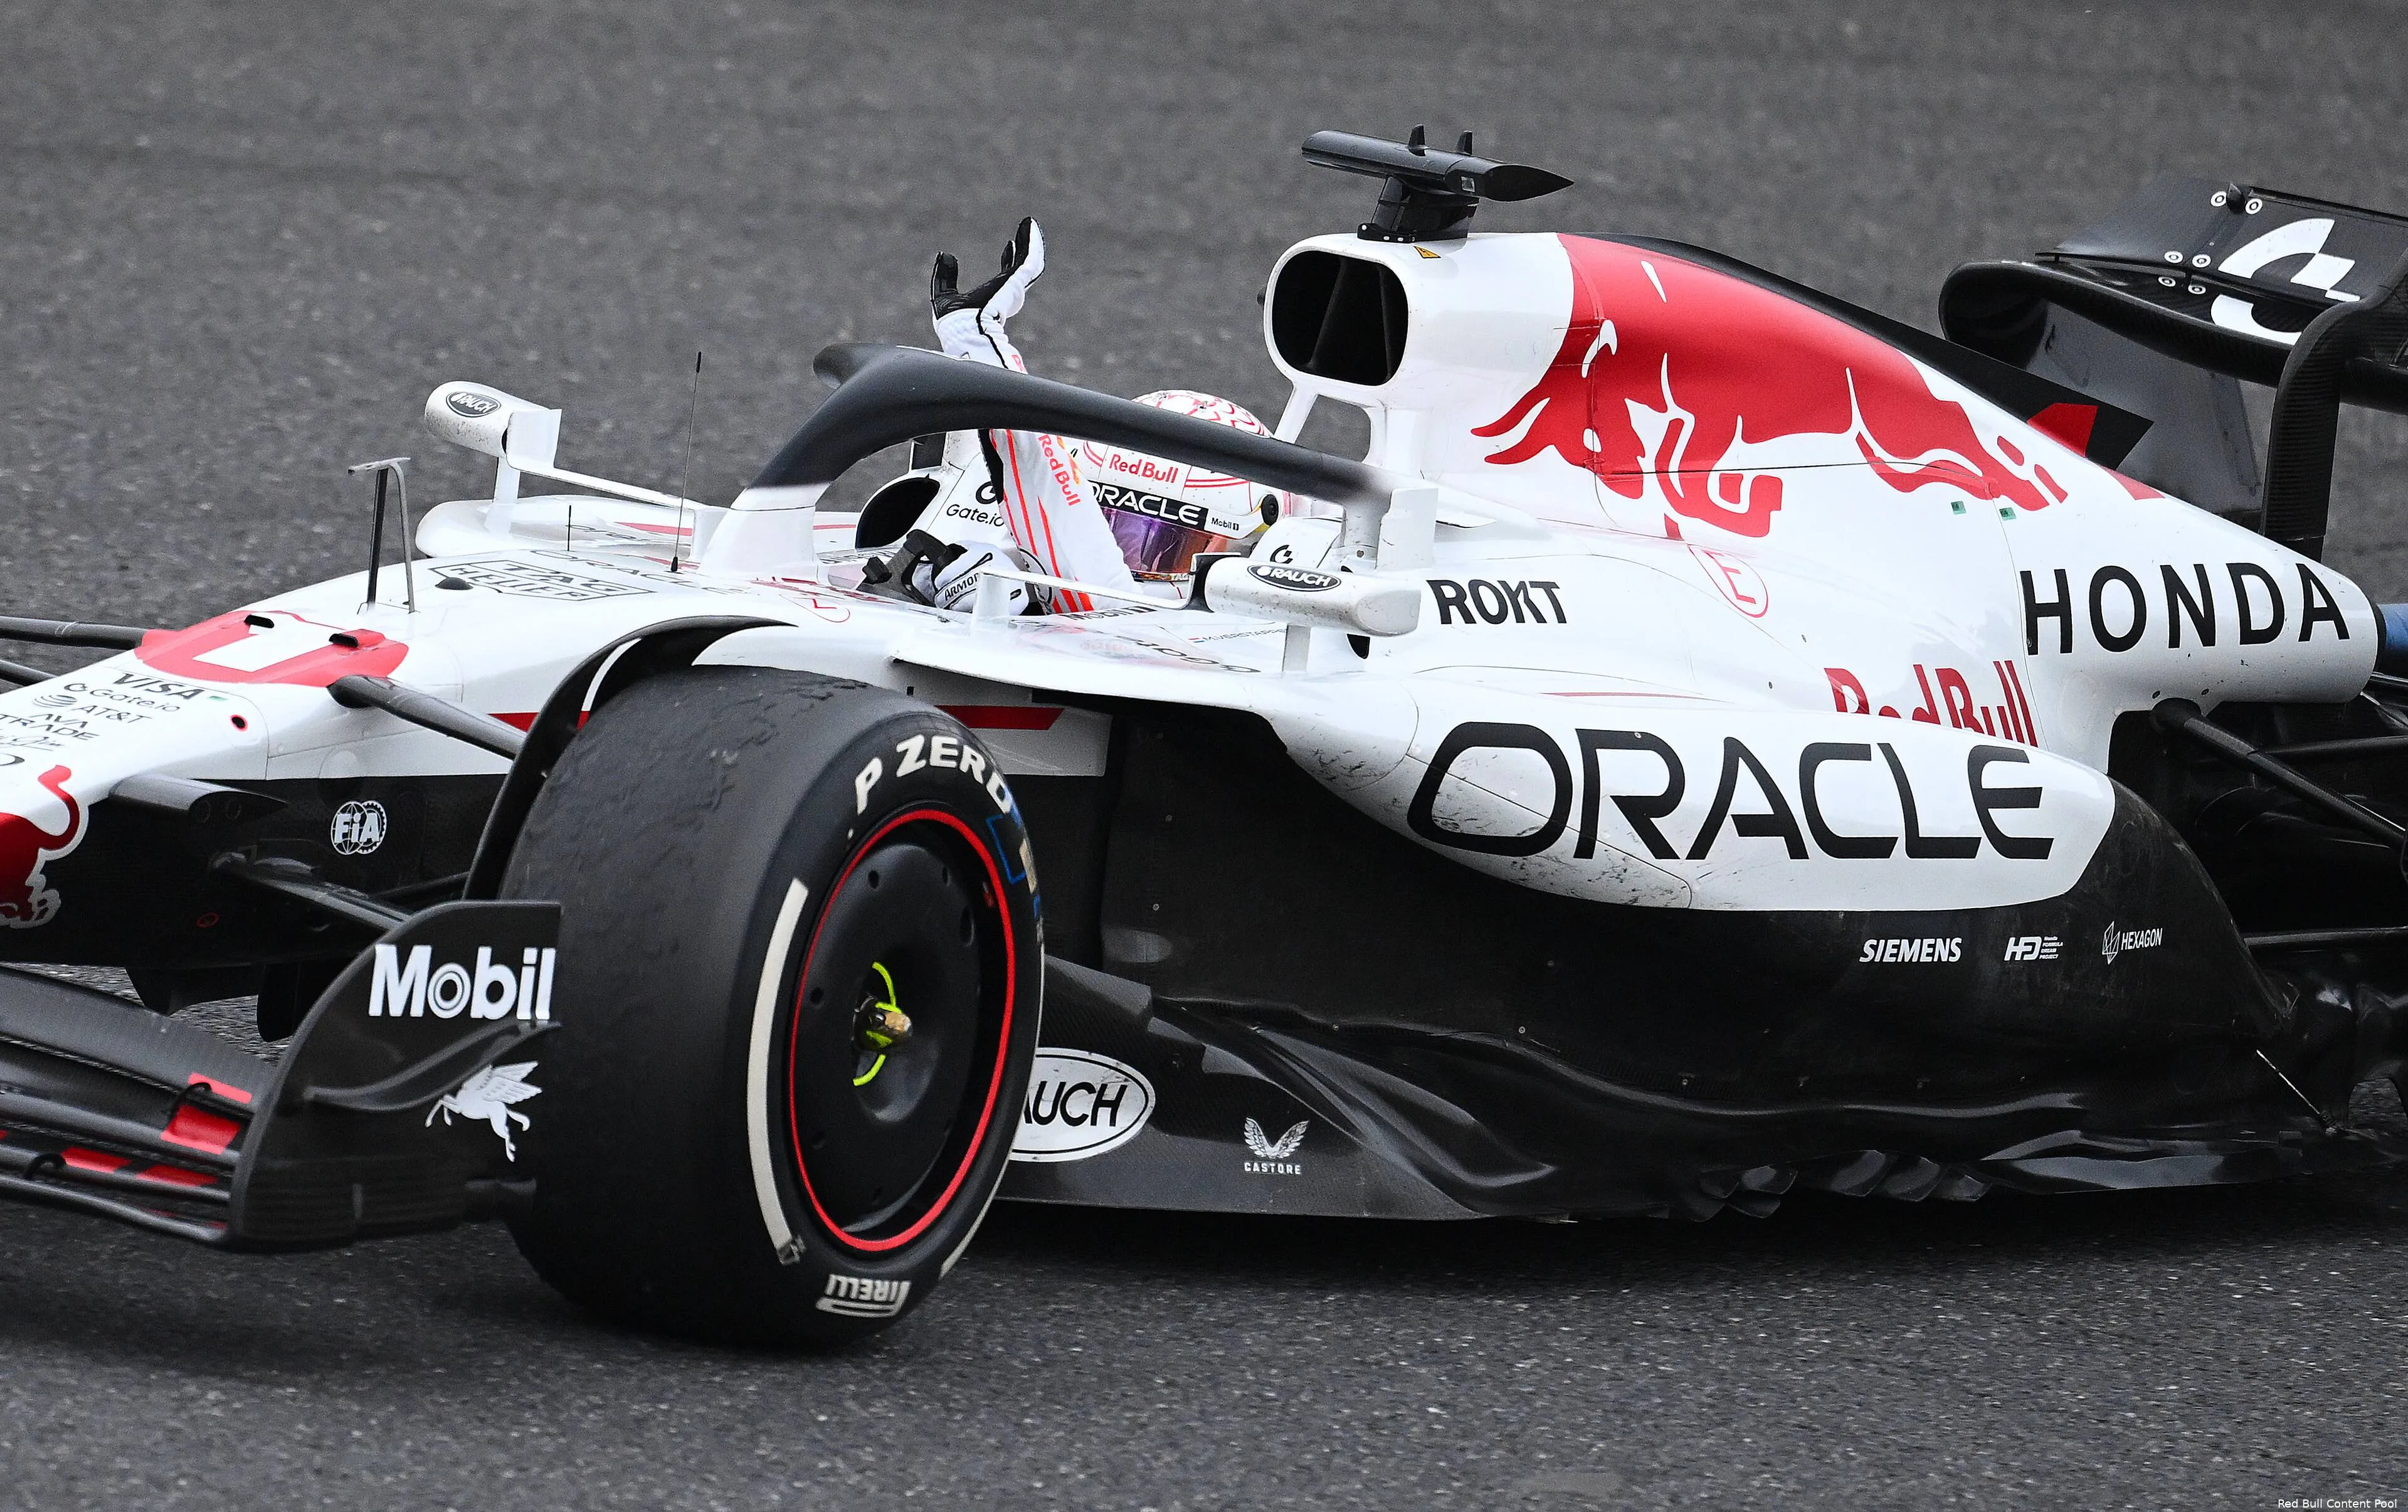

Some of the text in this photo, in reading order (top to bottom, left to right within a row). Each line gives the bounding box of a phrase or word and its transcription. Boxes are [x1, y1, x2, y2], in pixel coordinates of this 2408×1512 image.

[457, 394, 497, 413] RAUCH
[1054, 470, 1081, 507] Bull
[946, 504, 1005, 527] Gate.io
[1211, 517, 1232, 529] Mobil
[1270, 568, 1332, 587] RAUCH
[2019, 562, 2350, 656] HONDA
[113, 673, 206, 700] VISA
[1824, 663, 1941, 726] Rd
[89, 688, 181, 712] Gate.io
[70, 704, 152, 724] AT&T
[855, 734, 1015, 816] P ZERO
[1407, 721, 2056, 861] ORACLE
[1859, 937, 1963, 963] SIEMENS
[2121, 928, 2163, 951] HEXAGON
[368, 943, 557, 1020] Mobil
[1244, 1162, 1302, 1175] CASTORE
[816, 1273, 912, 1318] PIRELLI
